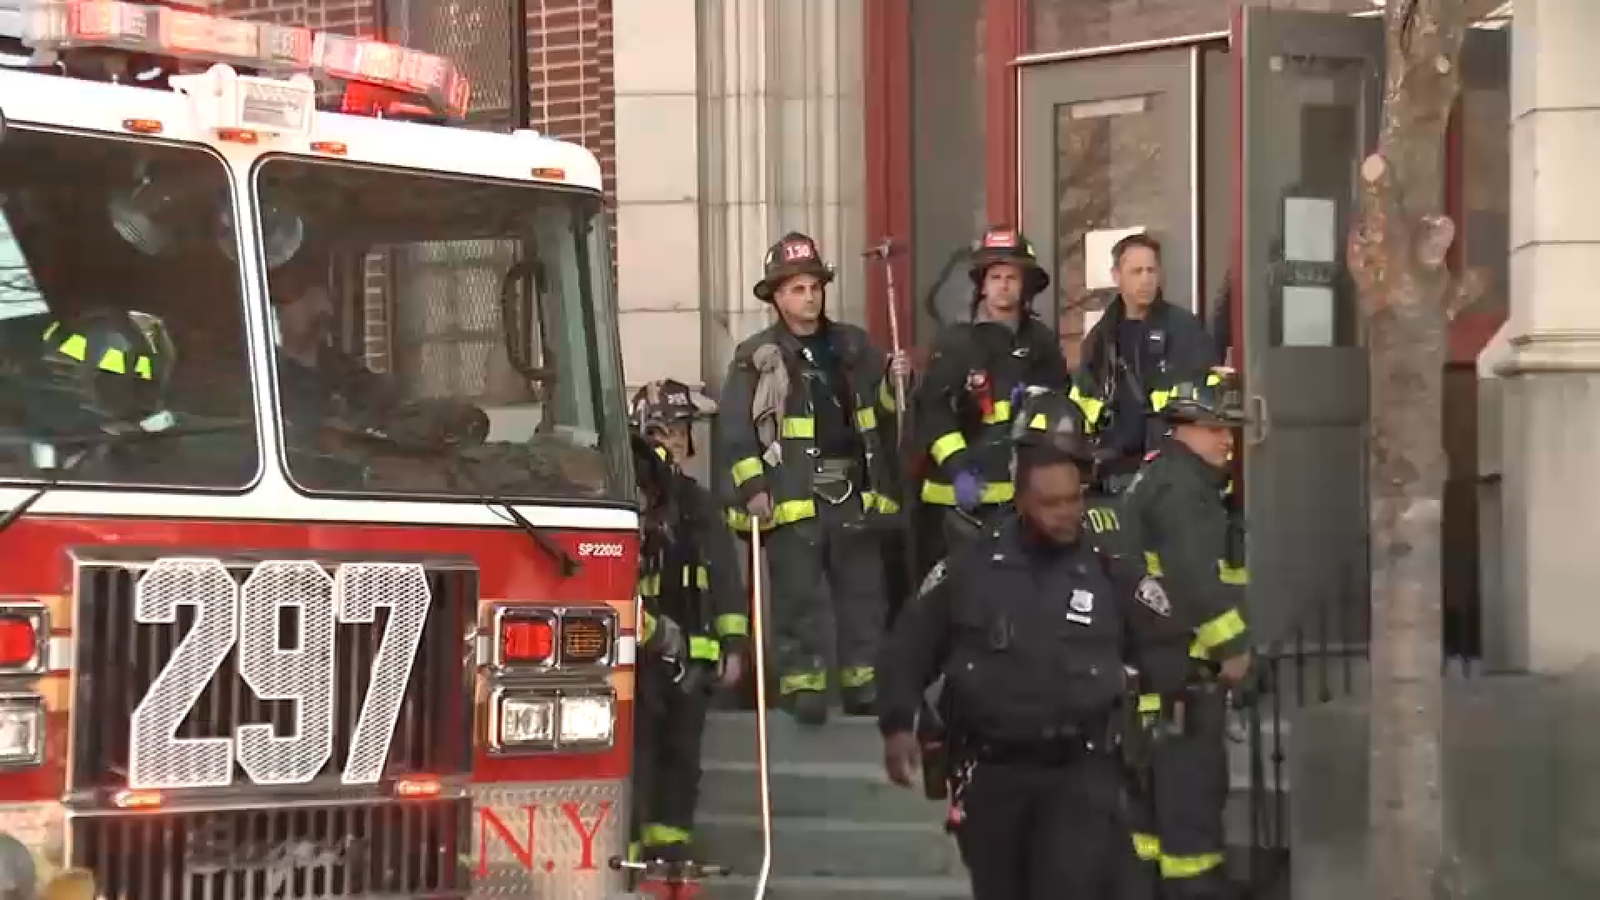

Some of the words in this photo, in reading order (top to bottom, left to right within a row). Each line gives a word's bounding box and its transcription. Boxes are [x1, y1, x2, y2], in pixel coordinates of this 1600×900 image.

[786, 244, 811, 259] 130
[578, 542, 624, 557] SP22002
[129, 557, 432, 788] 297
